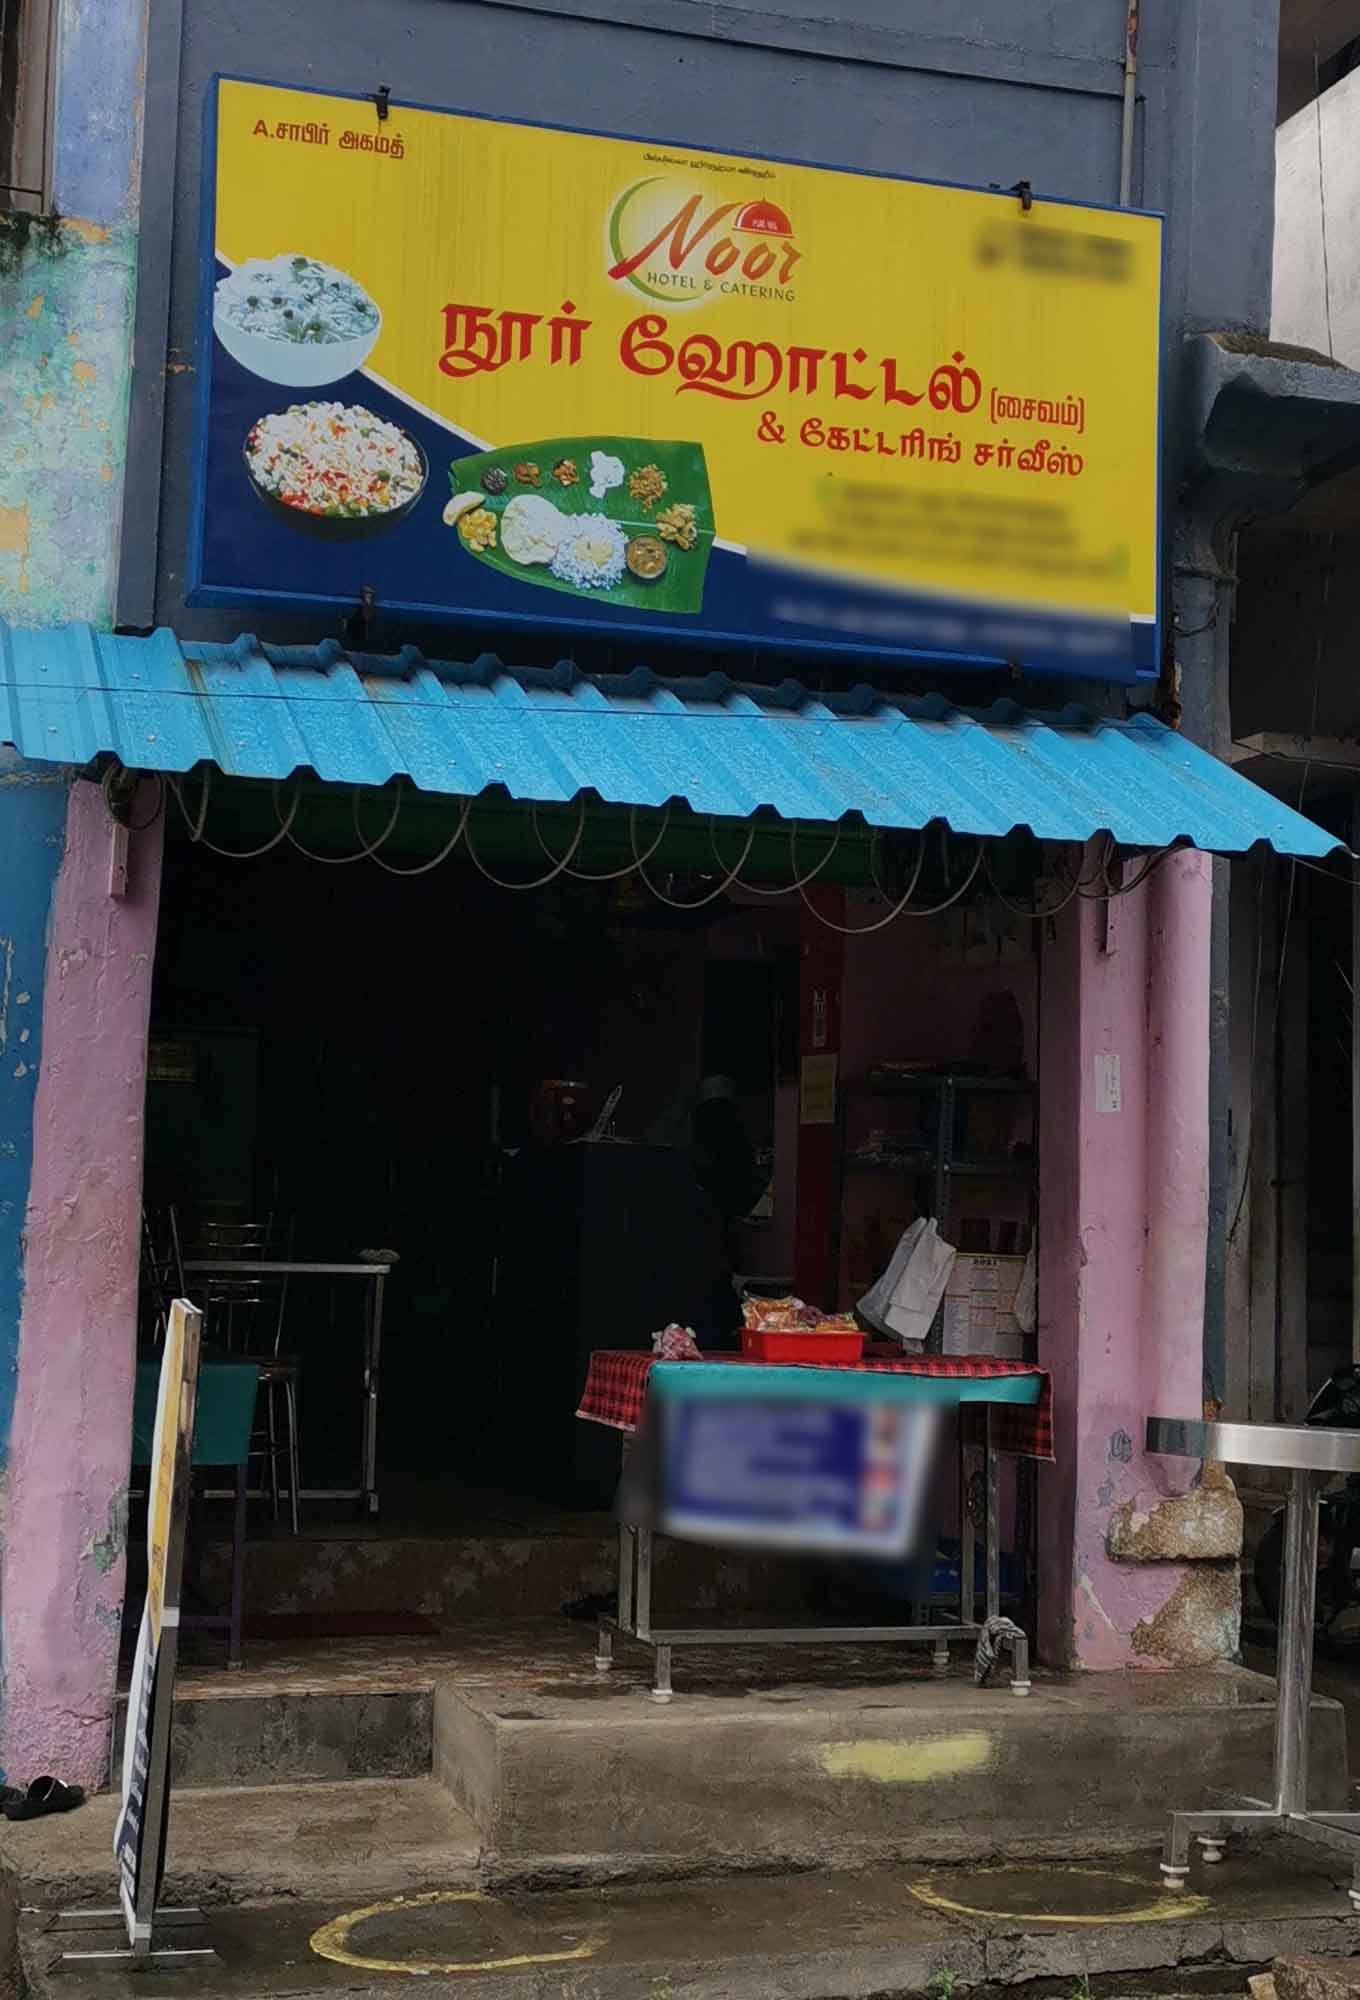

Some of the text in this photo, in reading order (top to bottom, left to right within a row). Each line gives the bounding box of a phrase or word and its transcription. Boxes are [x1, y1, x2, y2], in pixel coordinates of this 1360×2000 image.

[253, 119, 405, 160] A.சாபிர் அகமத்
[607, 194, 803, 286] Noor
[647, 271, 796, 302] HOTEL & CATERING
[619, 313, 982, 414] ஹோட்டல்
[756, 411, 1084, 477] & கேட்டரிங் சர்வீஸ்
